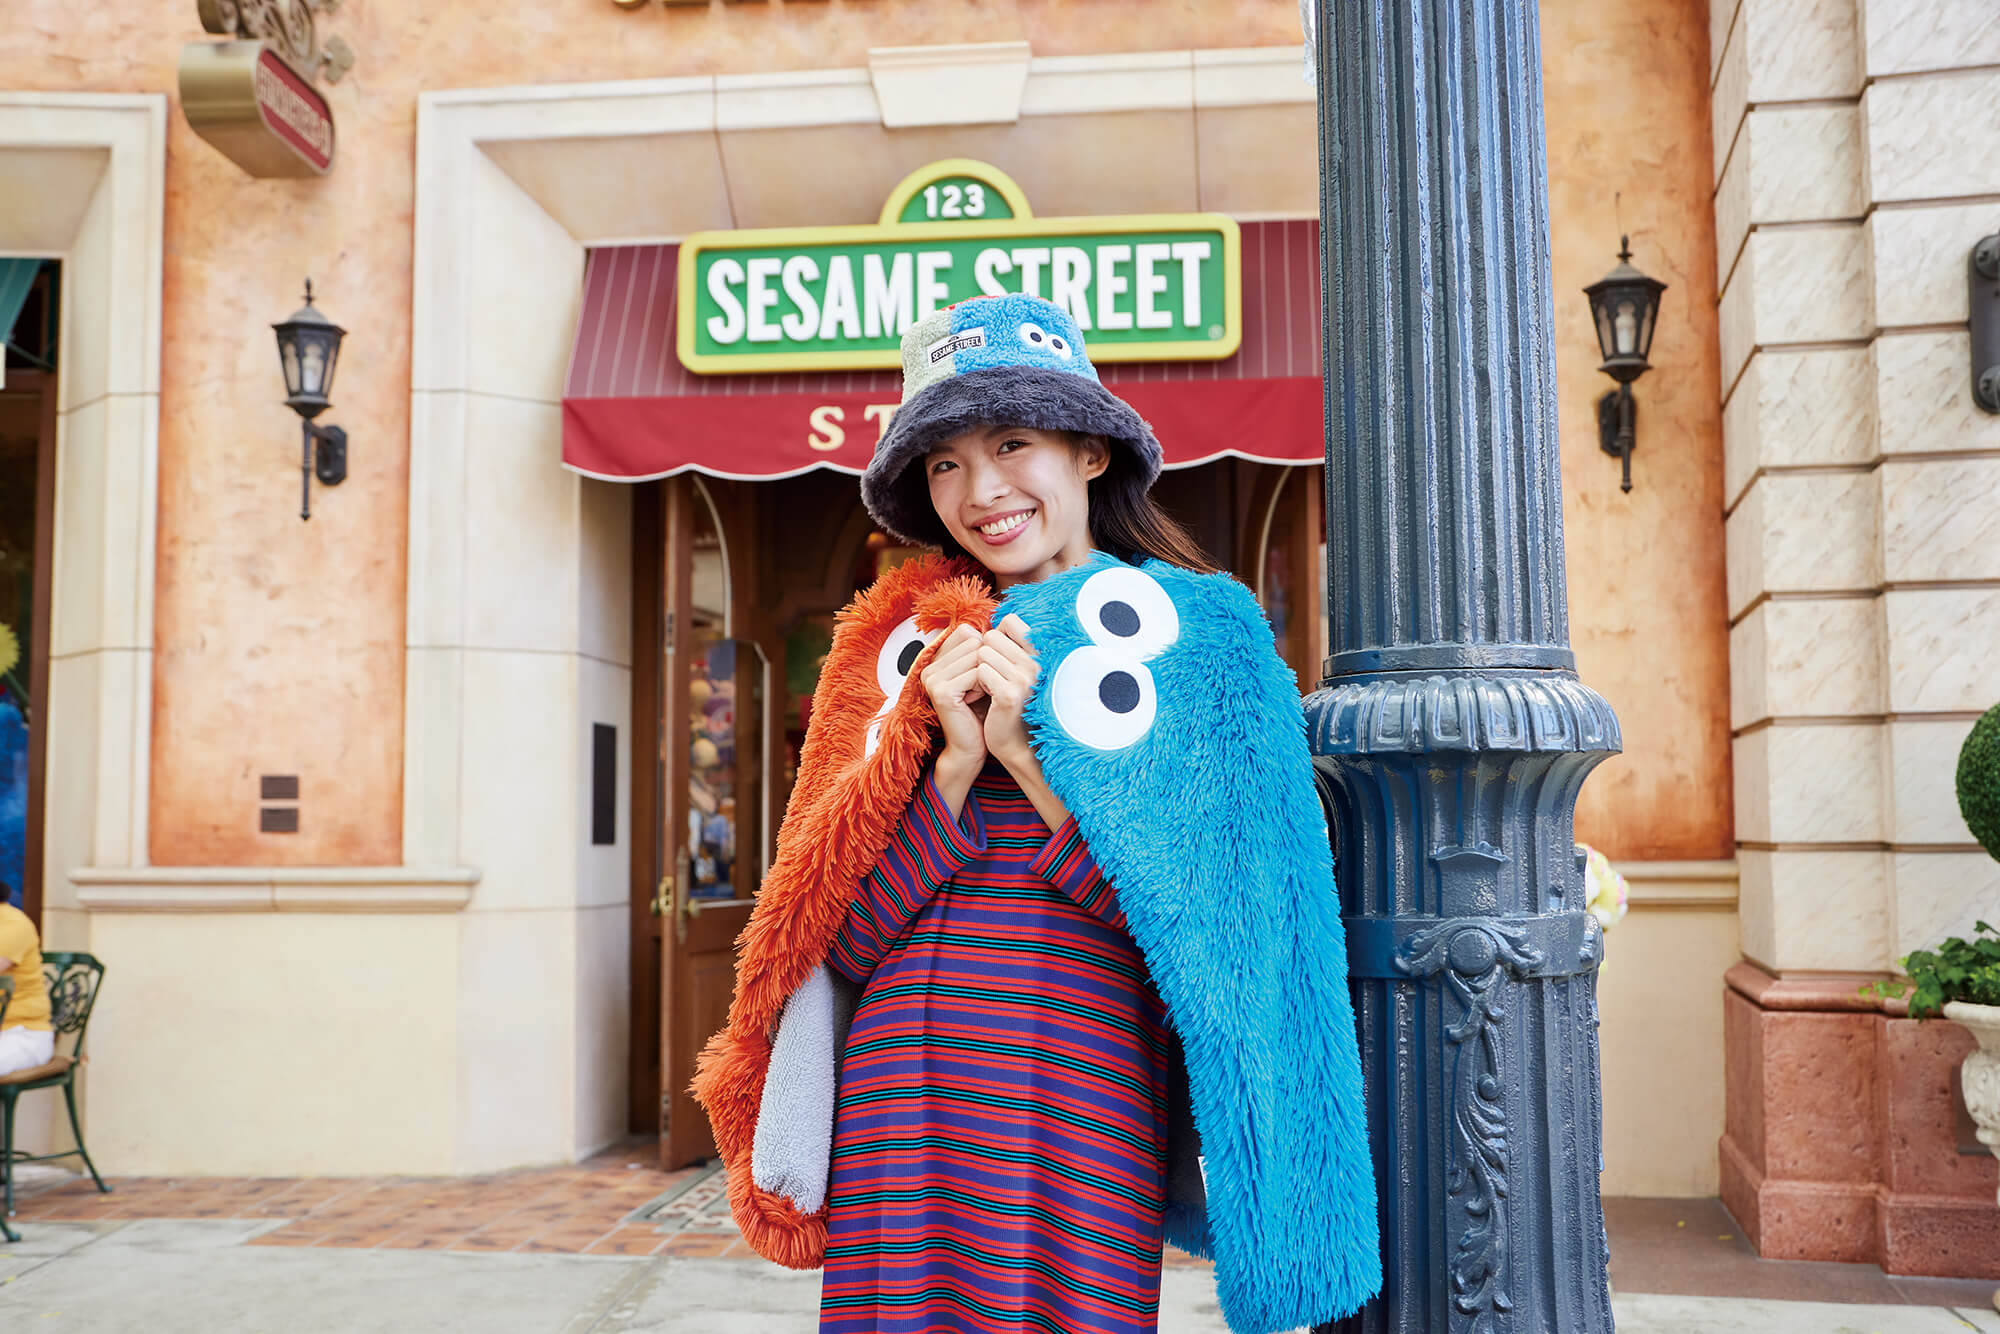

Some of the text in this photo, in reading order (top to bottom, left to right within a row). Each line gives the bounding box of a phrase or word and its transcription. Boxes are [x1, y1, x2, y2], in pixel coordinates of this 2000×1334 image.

[923, 184, 985, 218] 123
[707, 241, 1211, 344] SESAME STREET
[931, 344, 955, 361] SESAME
